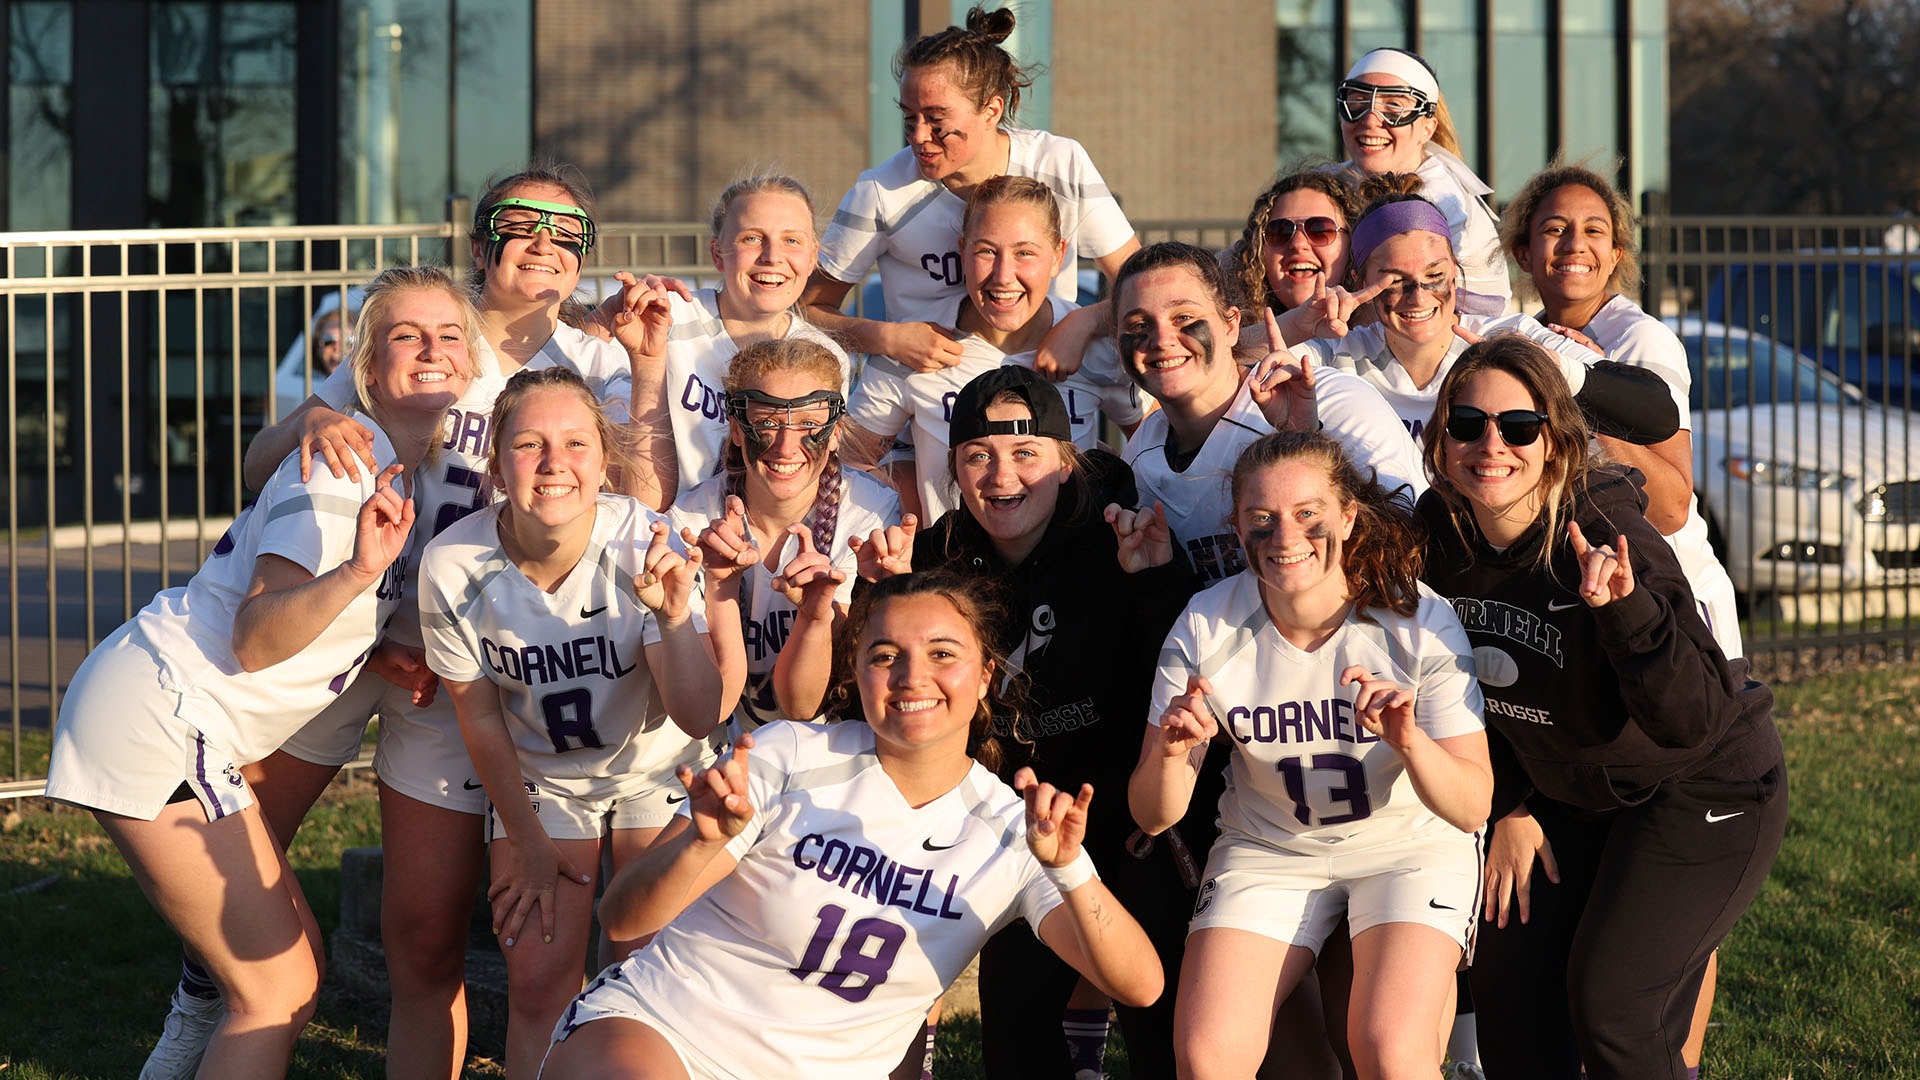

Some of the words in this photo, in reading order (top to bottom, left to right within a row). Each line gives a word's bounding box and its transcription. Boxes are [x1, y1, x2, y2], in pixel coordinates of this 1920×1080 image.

[921, 252, 966, 286] CO
[443, 408, 492, 458] OR
[746, 609, 798, 661] RNE
[1449, 597, 1563, 669] ORNELL
[481, 635, 637, 686] CORNELL
[987, 697, 1101, 738] CROSSE
[1486, 698, 1553, 726] ROSSE
[1275, 752, 1374, 827] 13
[792, 833, 963, 920] CORNELL
[788, 902, 908, 1003] 18
